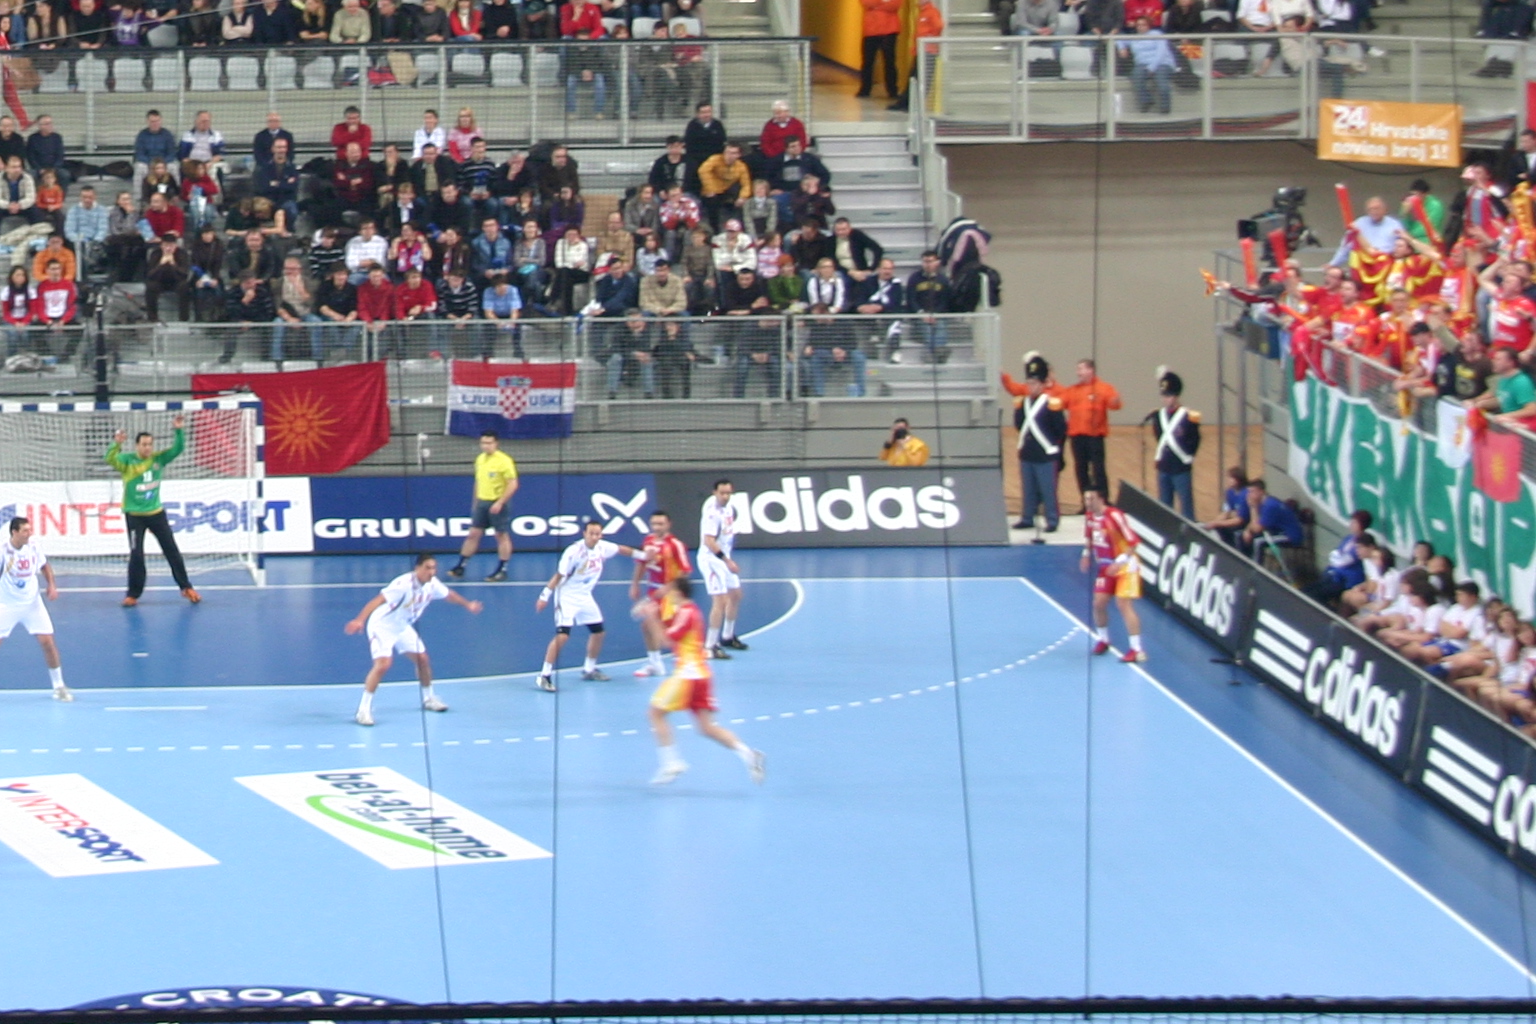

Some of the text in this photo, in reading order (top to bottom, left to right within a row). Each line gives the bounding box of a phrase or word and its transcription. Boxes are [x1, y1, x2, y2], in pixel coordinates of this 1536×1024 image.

[1332, 105, 1366, 130] 24
[1370, 122, 1448, 141] Hrvatske
[1331, 140, 1388, 157] novine
[1391, 142, 1427, 163] broj
[26, 499, 291, 536] INTESPORT
[314, 515, 581, 539] GRUNDOS
[1158, 542, 1235, 638] adidas
[1304, 646, 1401, 757] adidas
[4, 794, 147, 863] INTERSPORT
[314, 772, 508, 859] bet-at-home
